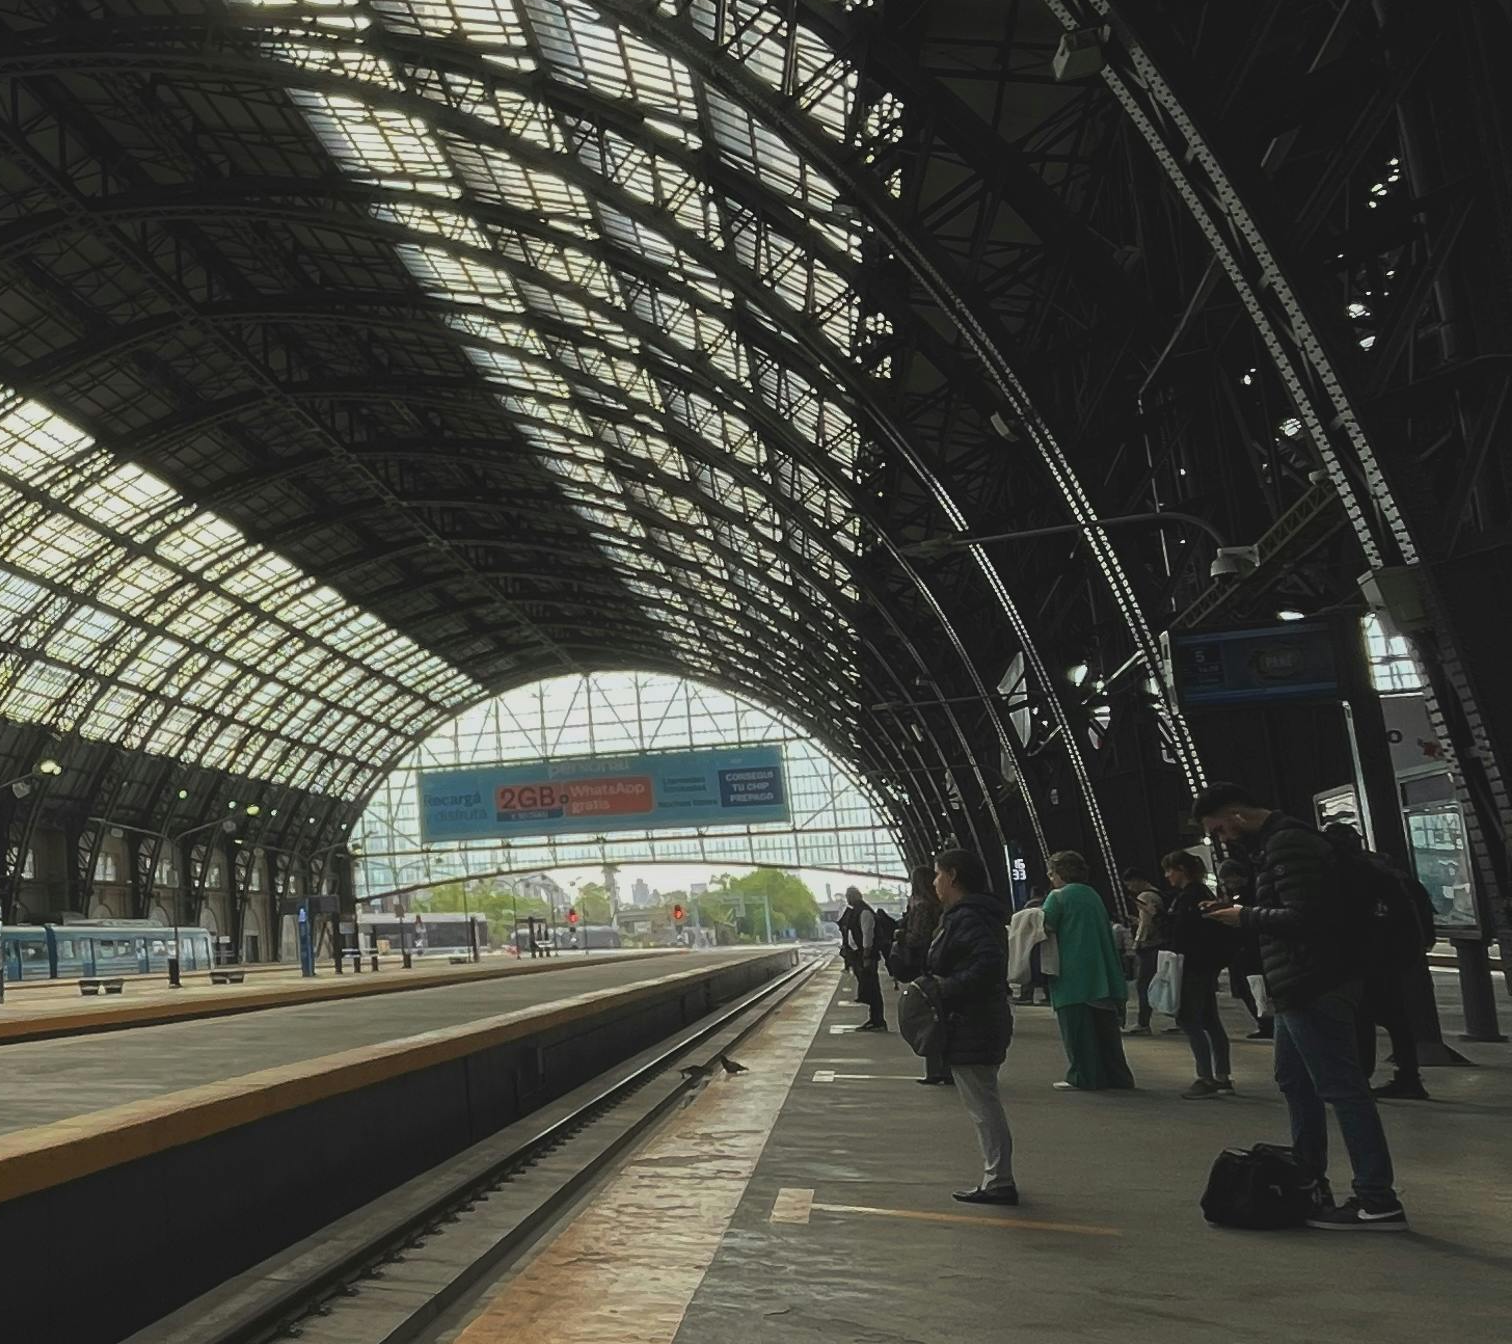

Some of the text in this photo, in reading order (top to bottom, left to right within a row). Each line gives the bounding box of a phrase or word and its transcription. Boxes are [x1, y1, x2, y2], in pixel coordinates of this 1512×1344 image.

[500, 786, 555, 809] 2GB
[570, 782, 646, 798] WhatsApp
[572, 800, 610, 814] gratis
[1012, 869, 1027, 881] 33
